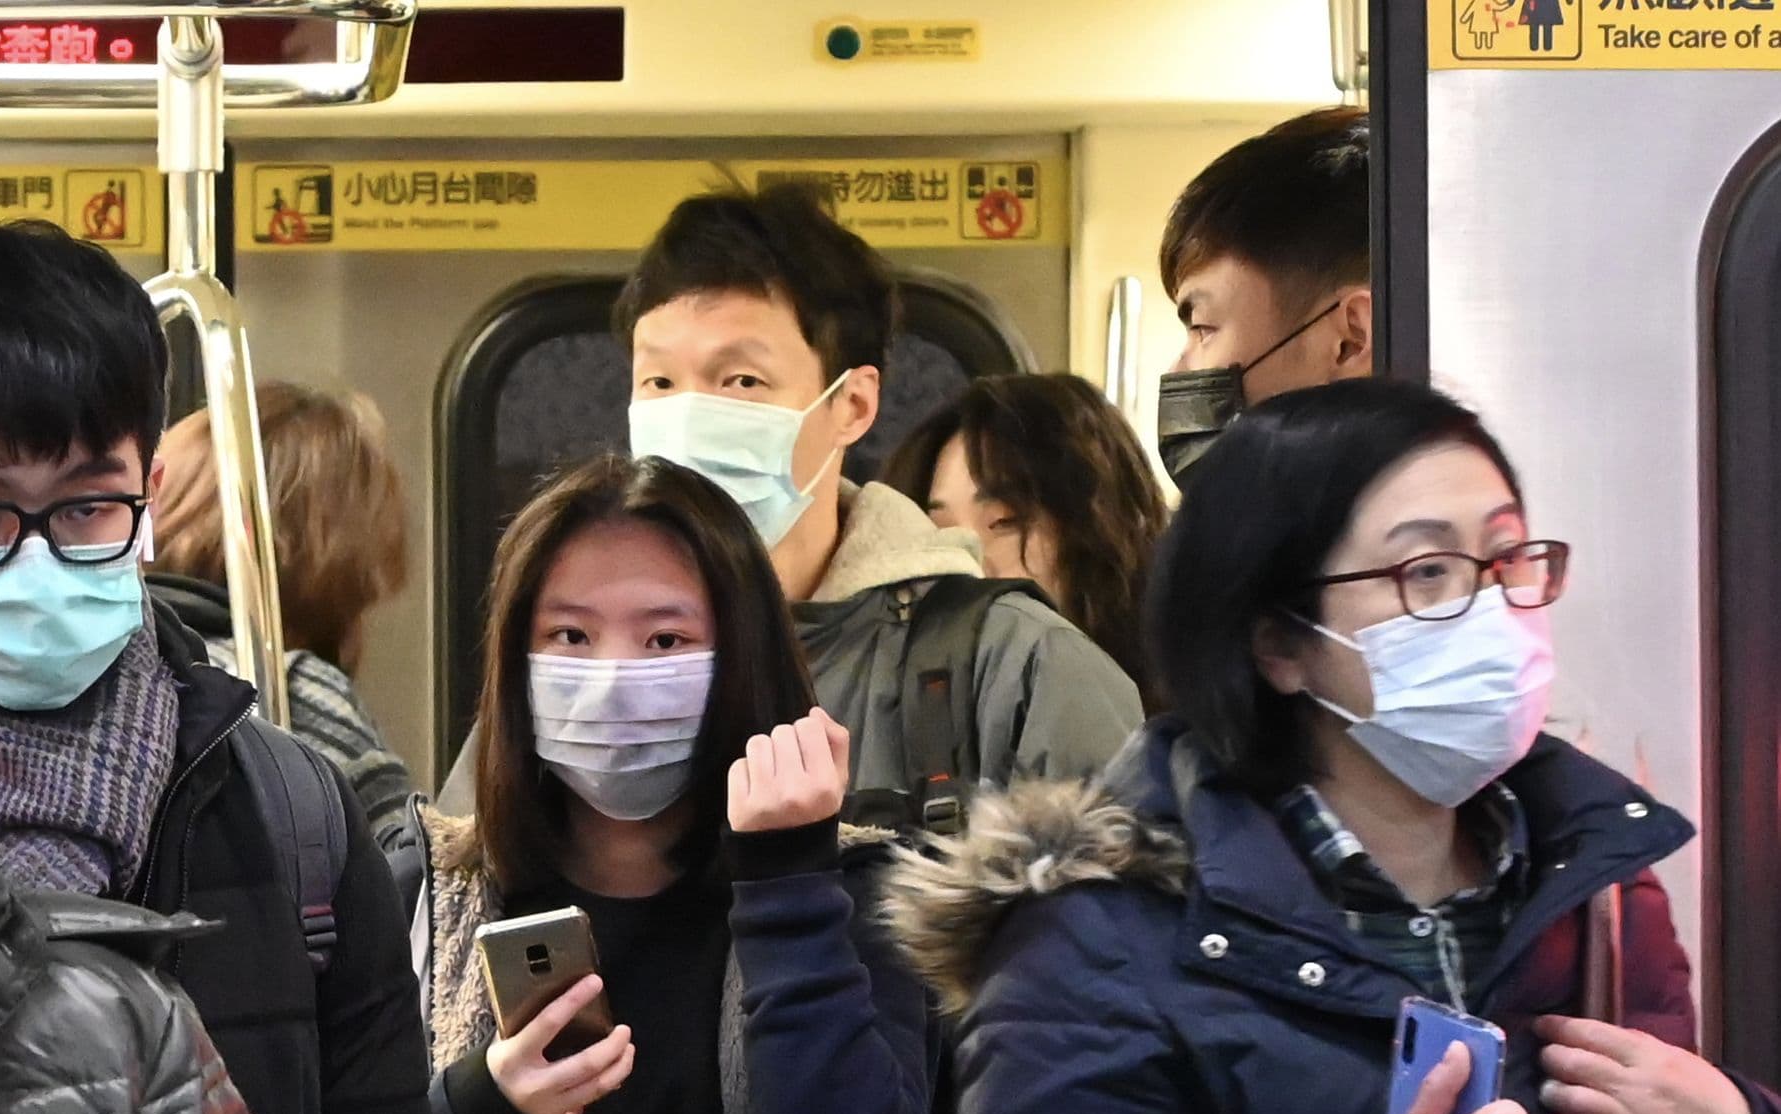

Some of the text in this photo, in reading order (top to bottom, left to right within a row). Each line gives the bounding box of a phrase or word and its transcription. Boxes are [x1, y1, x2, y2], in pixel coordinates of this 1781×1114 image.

[1598, 24, 1661, 49] Take
[1668, 29, 1727, 49] care
[1734, 24, 1762, 49] of
